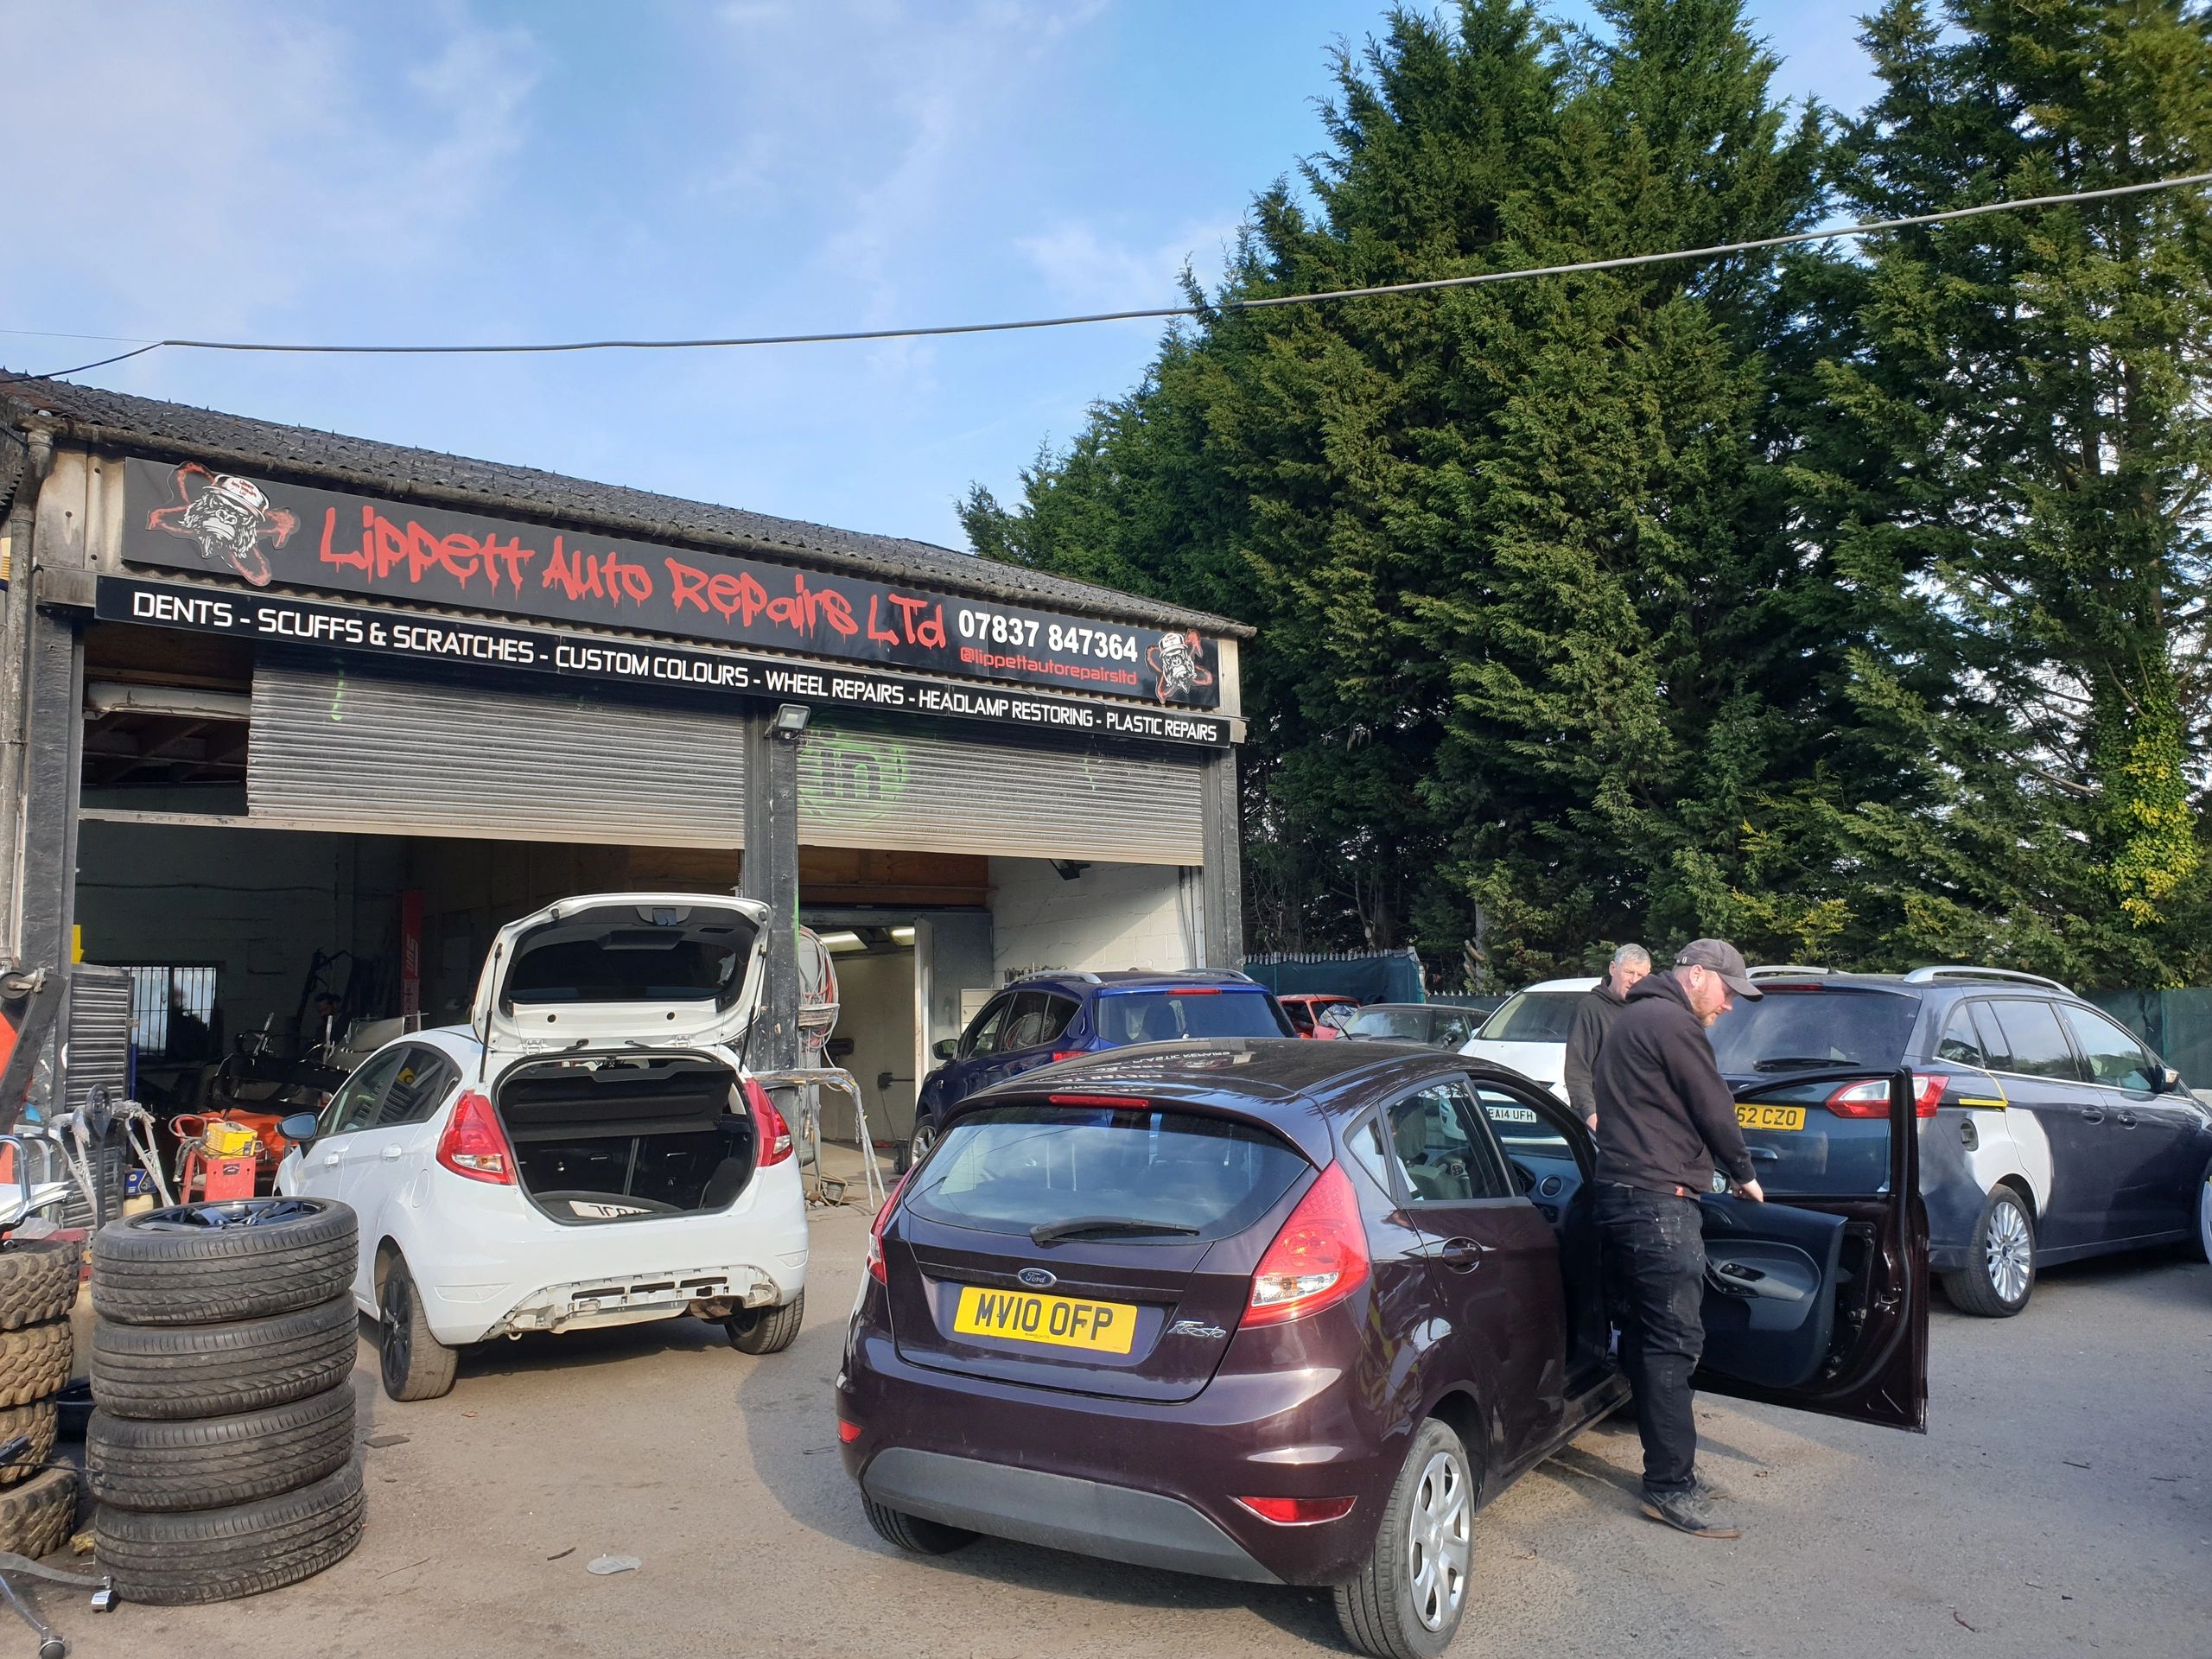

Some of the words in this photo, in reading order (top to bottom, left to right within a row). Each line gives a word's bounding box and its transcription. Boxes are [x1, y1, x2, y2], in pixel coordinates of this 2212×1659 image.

[319, 505, 536, 601] Lippett
[542, 535, 653, 607] Auto
[664, 557, 859, 643] Repairs
[958, 609, 1039, 648] 07837
[1048, 624, 1138, 663] 847364
[133, 591, 233, 627] DENTS
[258, 608, 364, 644] SCUFFS
[369, 622, 387, 646] &
[393, 625, 534, 664] SCRATCHES
[556, 645, 649, 677] CUSTOM
[654, 657, 749, 688] COLOURS
[765, 670, 829, 696] WHEEL
[832, 678, 905, 705] REPAIRS
[918, 689, 1010, 718] HEADLAMP
[1012, 700, 1093, 728] RESTORING
[1106, 711, 1162, 735] PLASTIC
[1165, 718, 1217, 742] REPAIRS
[960, 646, 1137, 686] @lippettautorepairsltd
[1513, 1109, 1533, 1121] UFH
[1736, 1107, 1758, 1123] 62
[1762, 1108, 1797, 1126] CZO
[975, 1293, 1043, 1332] MV10
[1049, 1301, 1114, 1341] OFP
